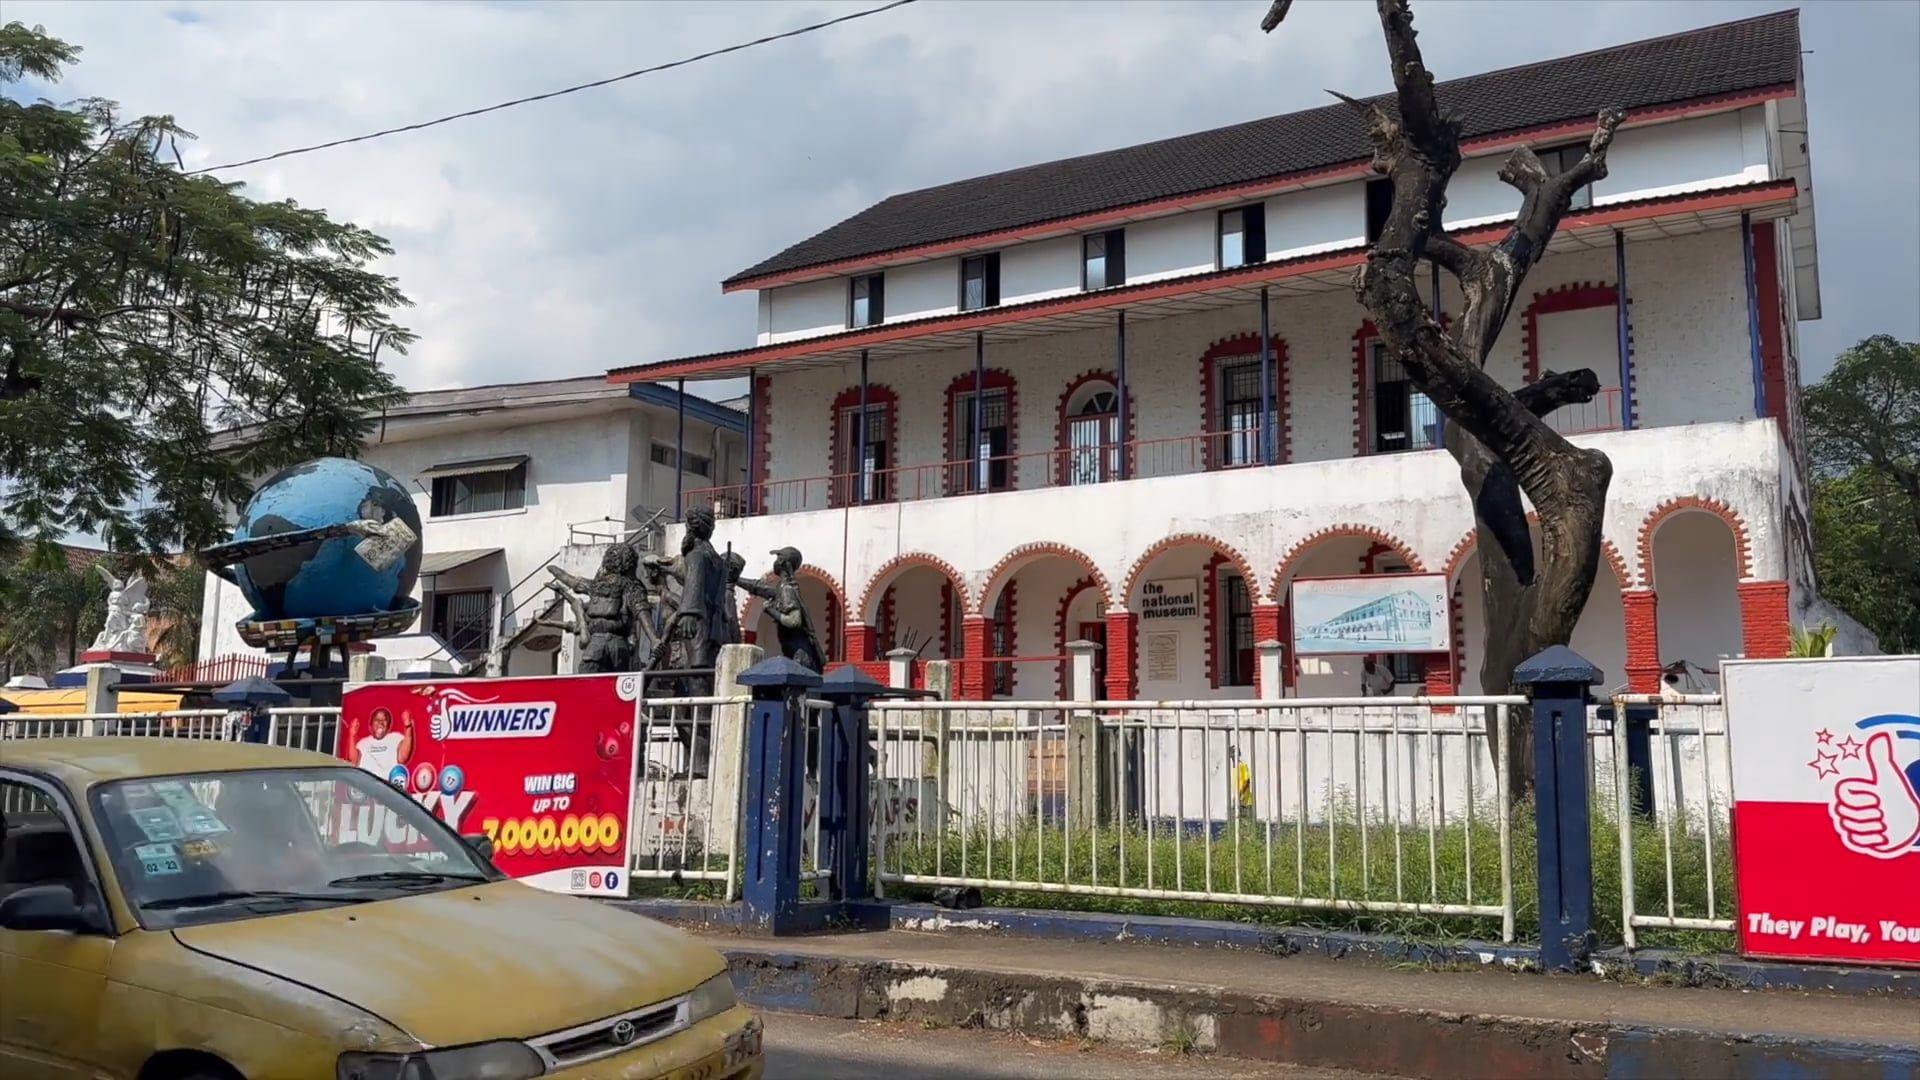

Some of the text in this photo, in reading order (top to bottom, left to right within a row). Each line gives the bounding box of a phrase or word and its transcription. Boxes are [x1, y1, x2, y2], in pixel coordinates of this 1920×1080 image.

[1143, 582, 1164, 595] the
[1142, 591, 1194, 608] national
[1143, 606, 1197, 620] museum
[452, 707, 551, 733] WINNERS
[446, 775, 456, 786] 17
[524, 772, 577, 793] WIN BIG
[533, 796, 571, 813] UP TO
[482, 814, 621, 852] 7,000,000
[146, 860, 178, 873] 02 23
[1747, 912, 1920, 944] They Play, You
